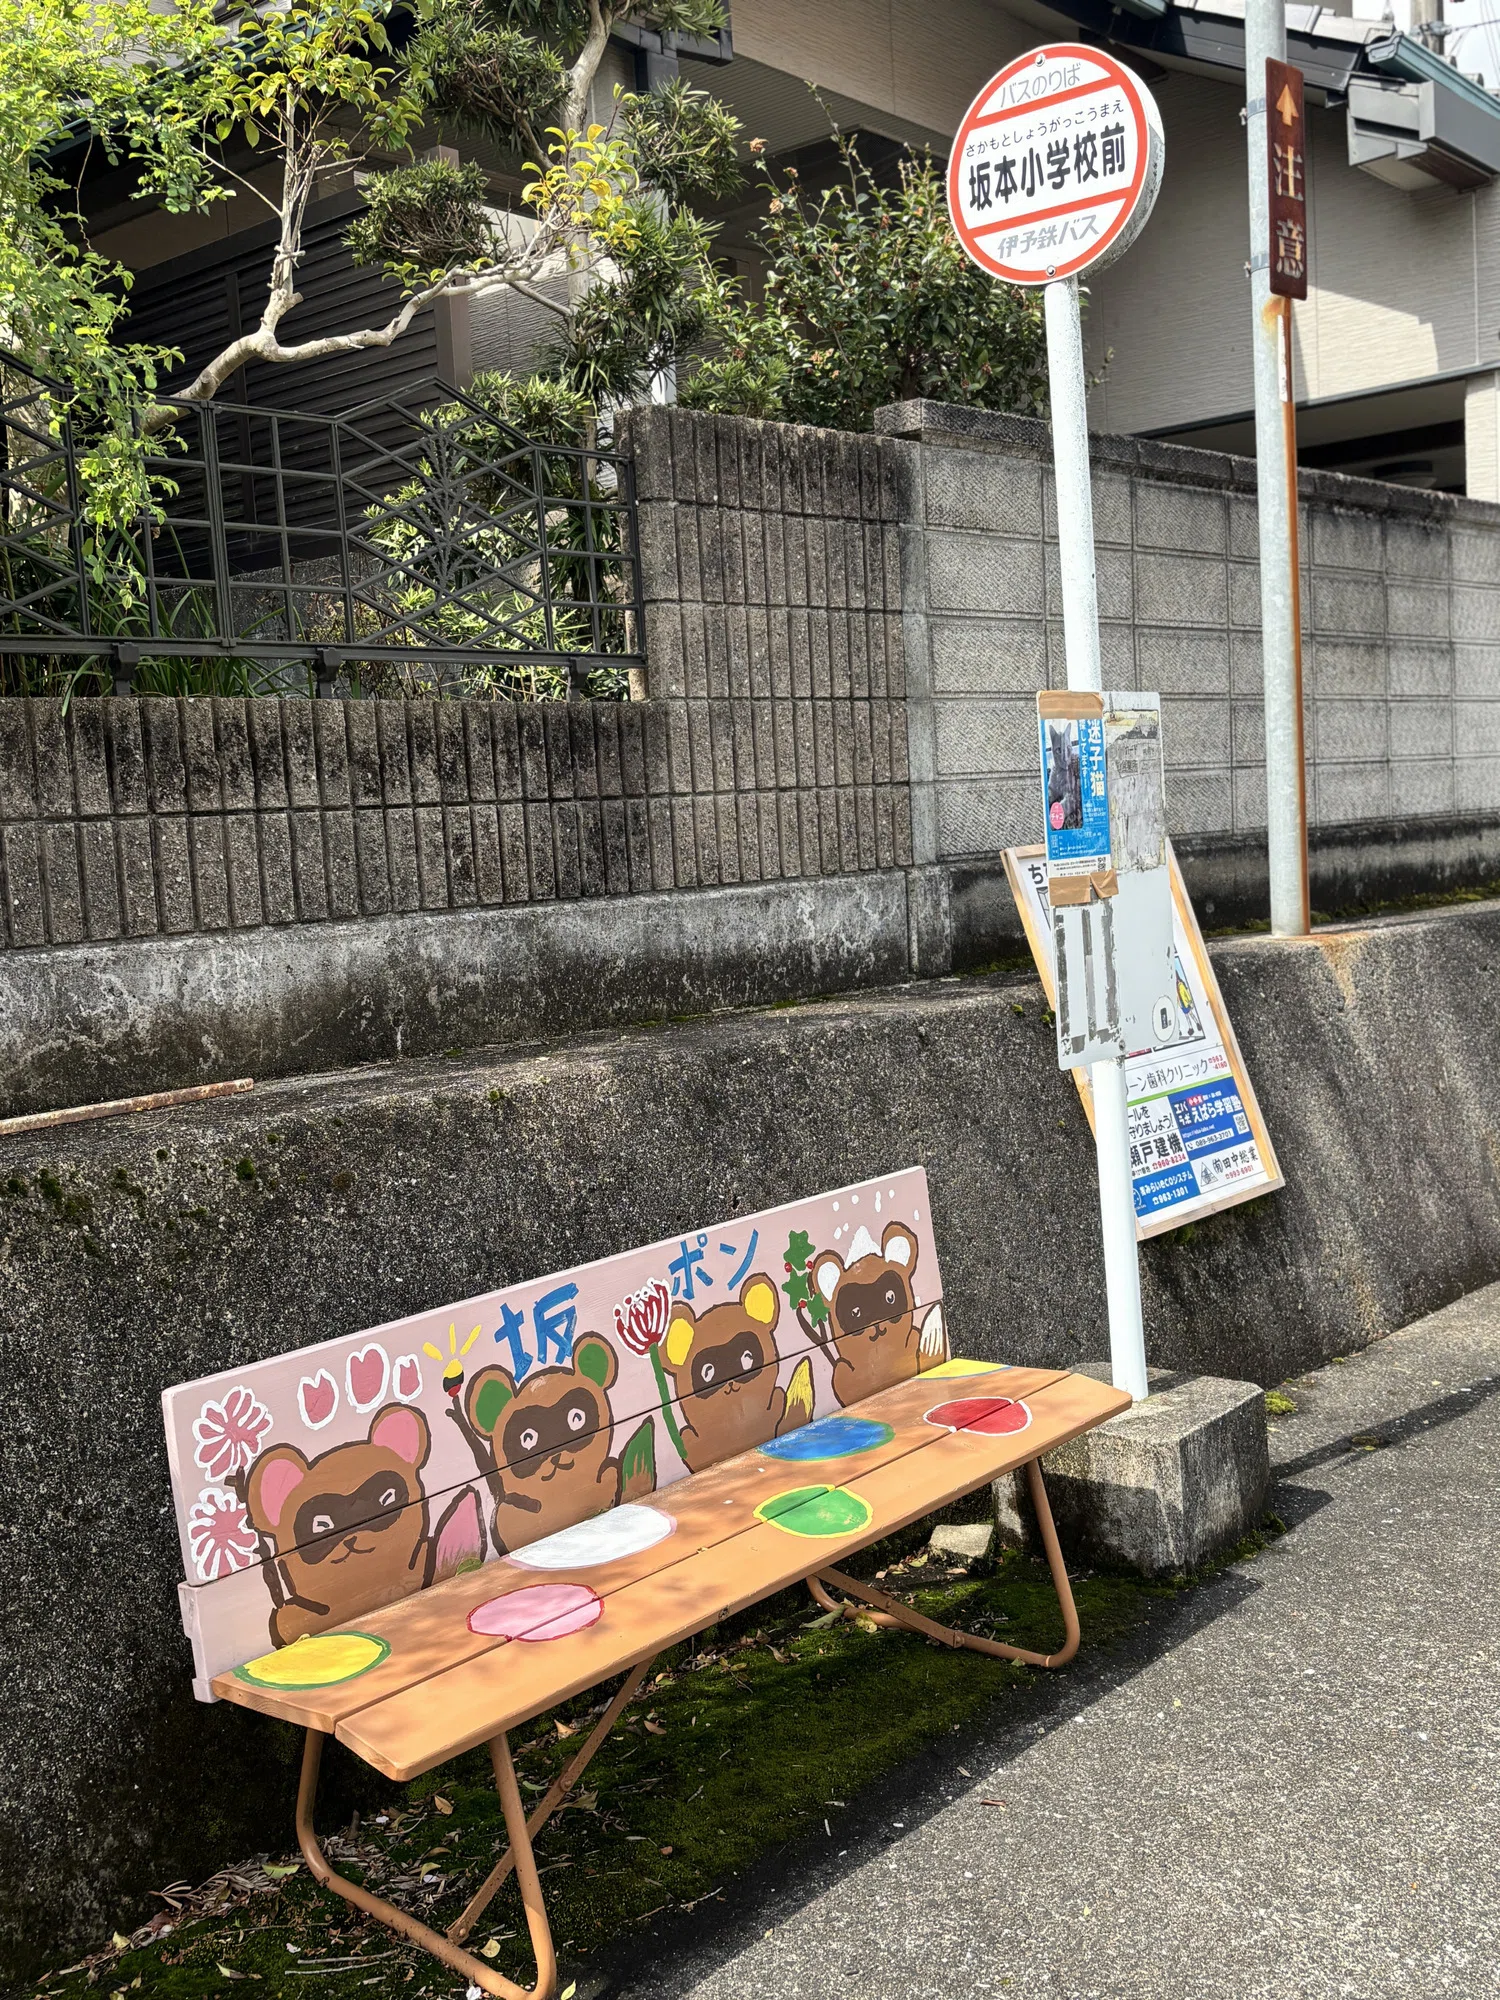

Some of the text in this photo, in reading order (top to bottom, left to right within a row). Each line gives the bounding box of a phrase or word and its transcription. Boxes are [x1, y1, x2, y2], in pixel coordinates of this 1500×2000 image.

[999, 62, 1082, 108] バスのりば
[966, 100, 1125, 157] さかもとしょうがっこうまえ
[968, 122, 1126, 211] 坂本小学校前
[1273, 142, 1304, 279] 注意
[998, 214, 1100, 259] 伊予鉄バス
[1191, 1095, 1243, 1123] えばら学習塾
